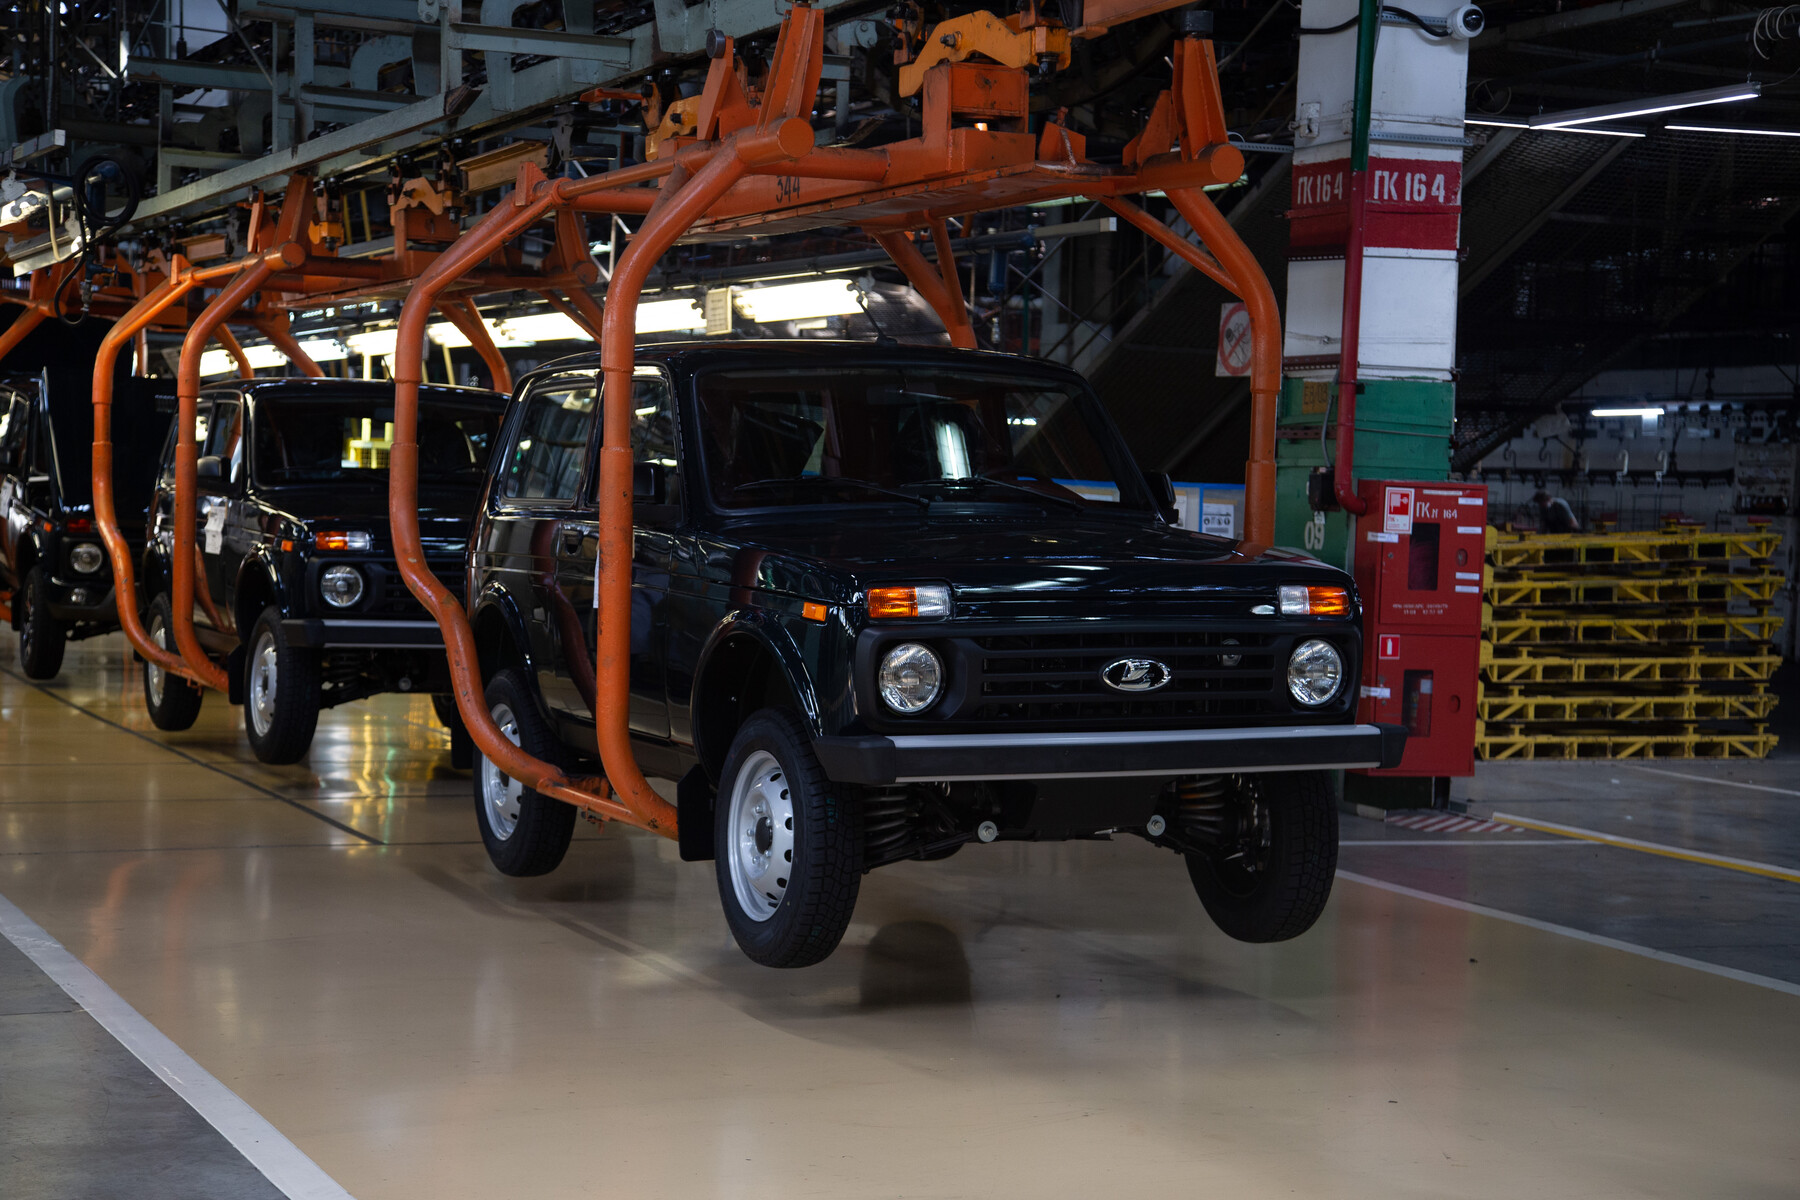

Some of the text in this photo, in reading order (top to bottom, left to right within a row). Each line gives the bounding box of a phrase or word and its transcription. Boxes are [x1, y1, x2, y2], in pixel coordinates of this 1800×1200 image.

[1316, 171, 1343, 203] 164
[1373, 170, 1446, 203] ПК 164
[1304, 521, 1325, 551] 09
